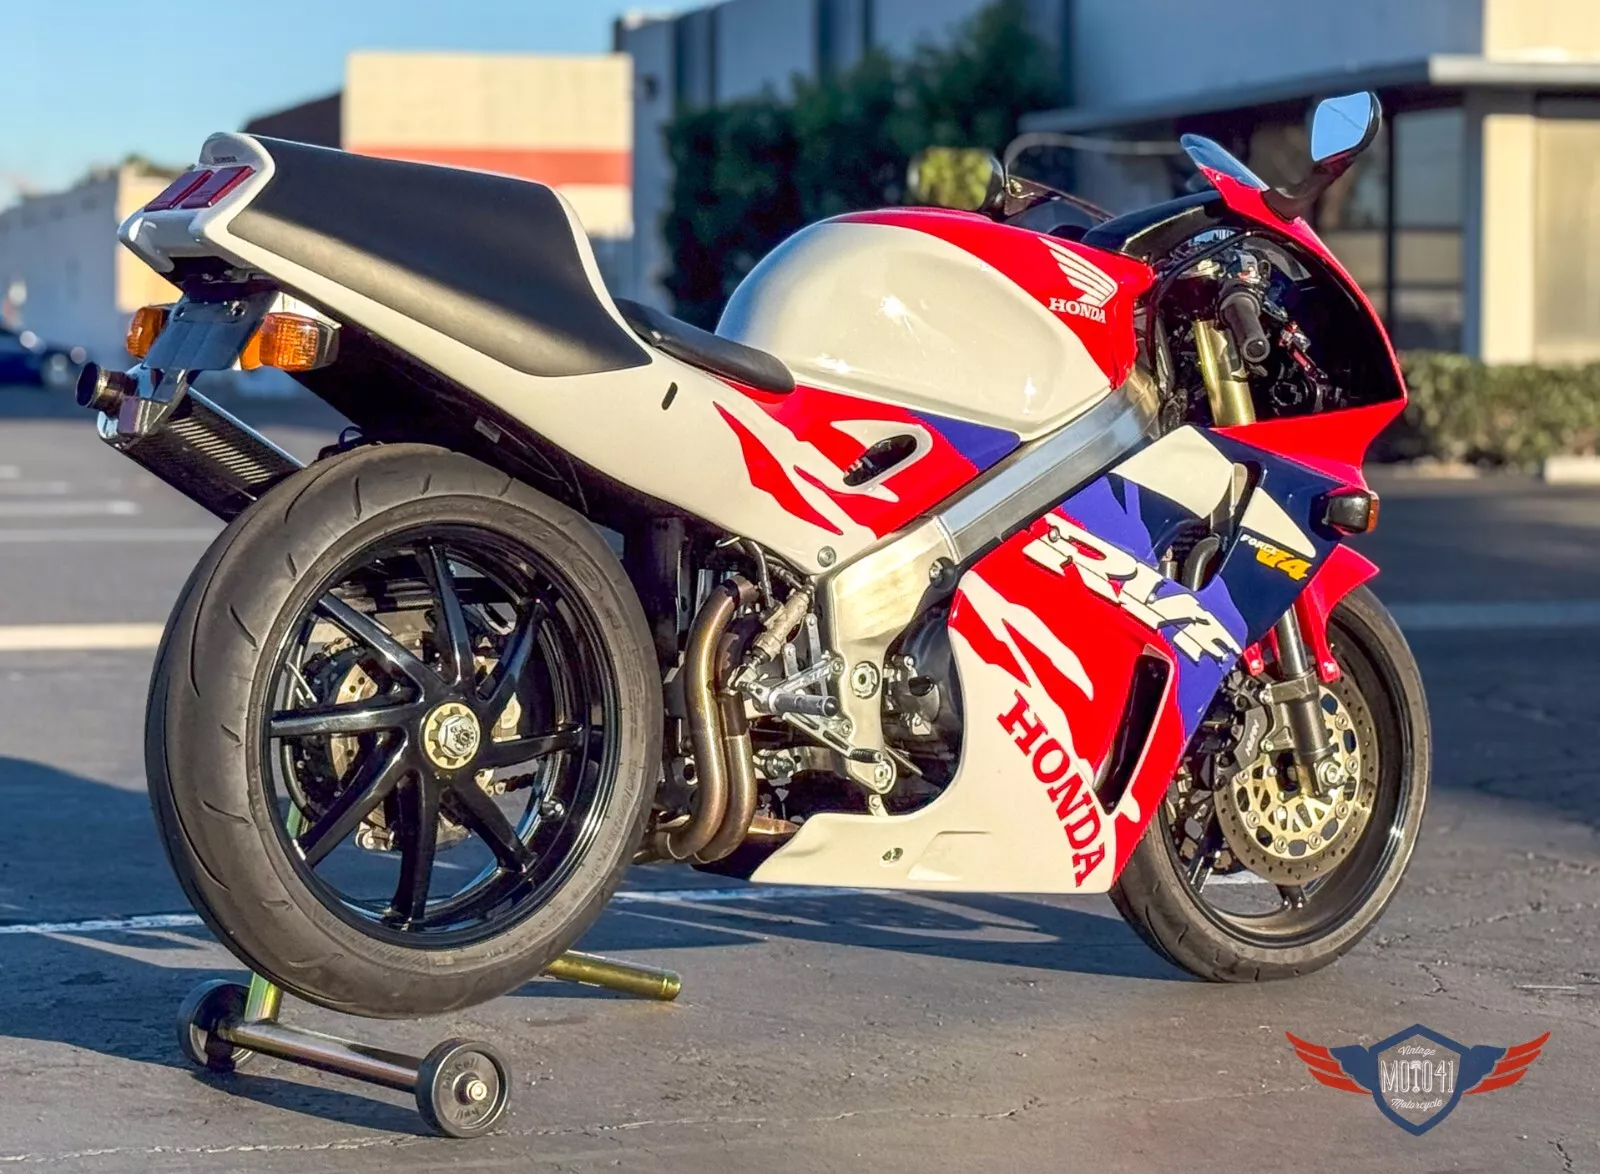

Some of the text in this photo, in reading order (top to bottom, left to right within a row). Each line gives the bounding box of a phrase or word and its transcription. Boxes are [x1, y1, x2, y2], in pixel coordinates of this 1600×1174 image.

[1048, 297, 1106, 324] HONDA
[1022, 512, 1243, 668] RVF
[1256, 546, 1312, 581] V4
[997, 689, 1105, 888] HONDA
